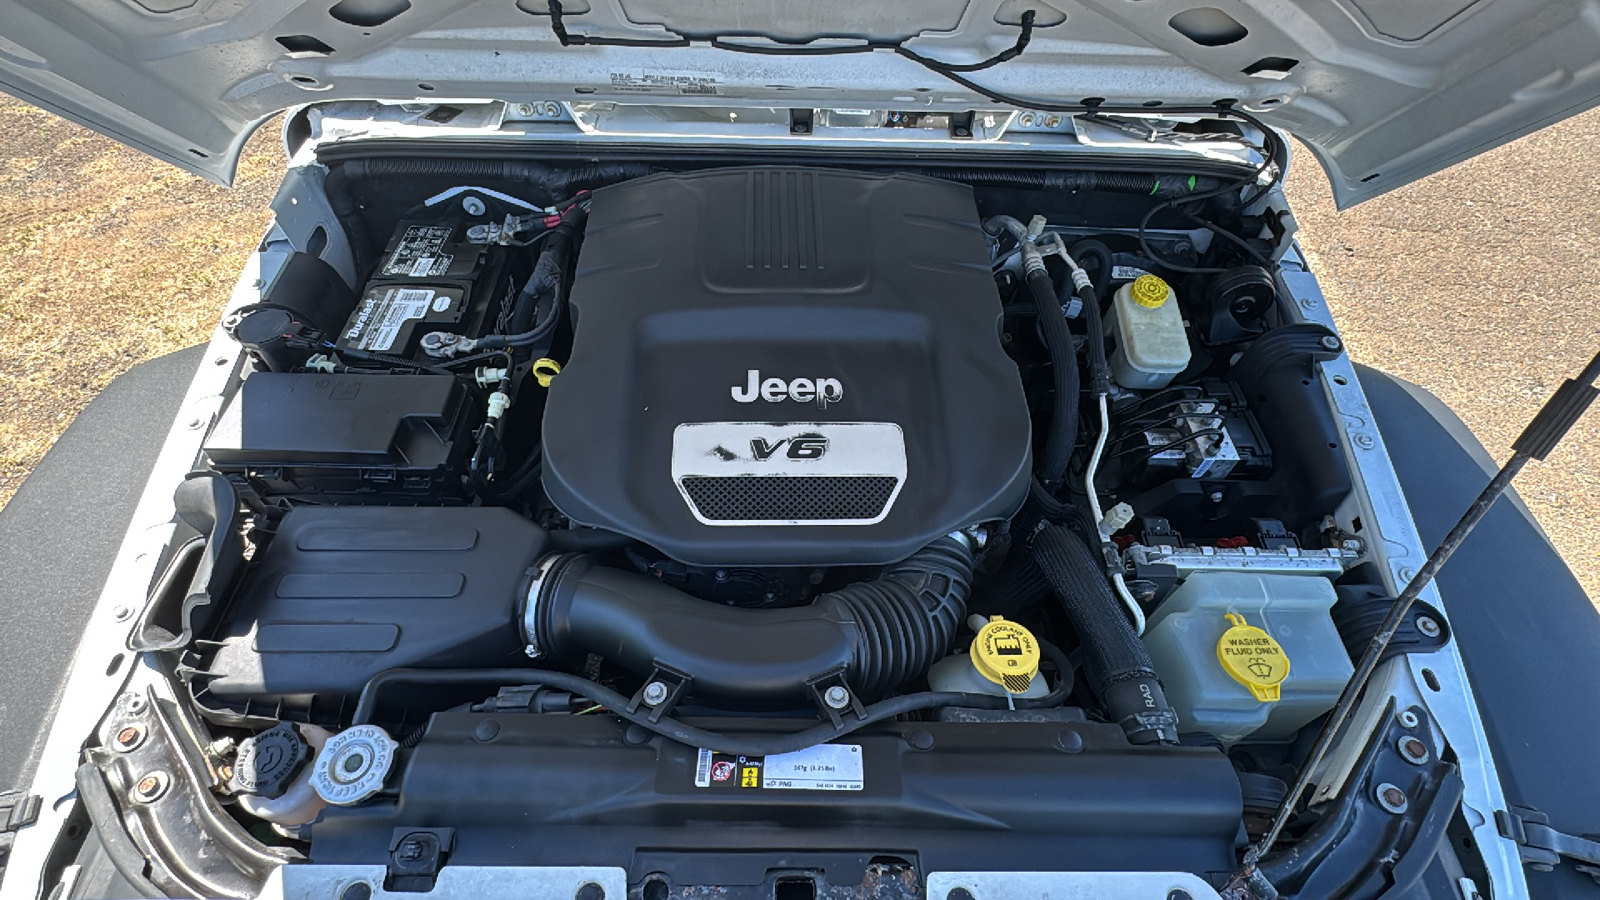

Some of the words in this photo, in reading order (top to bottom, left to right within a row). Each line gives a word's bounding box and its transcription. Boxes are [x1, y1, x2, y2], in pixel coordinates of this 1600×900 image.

[344, 297, 378, 339] Duralast
[731, 369, 843, 410] Jeep
[750, 436, 830, 462] V6
[984, 633, 994, 655] ENGINE
[991, 626, 1023, 636] COOLANT
[1022, 636, 1033, 654] ONLY
[1225, 647, 1253, 655] FLUID
[1255, 647, 1279, 655] ONLY
[1228, 638, 1271, 646] WASHER
[1140, 683, 1156, 708] RAD
